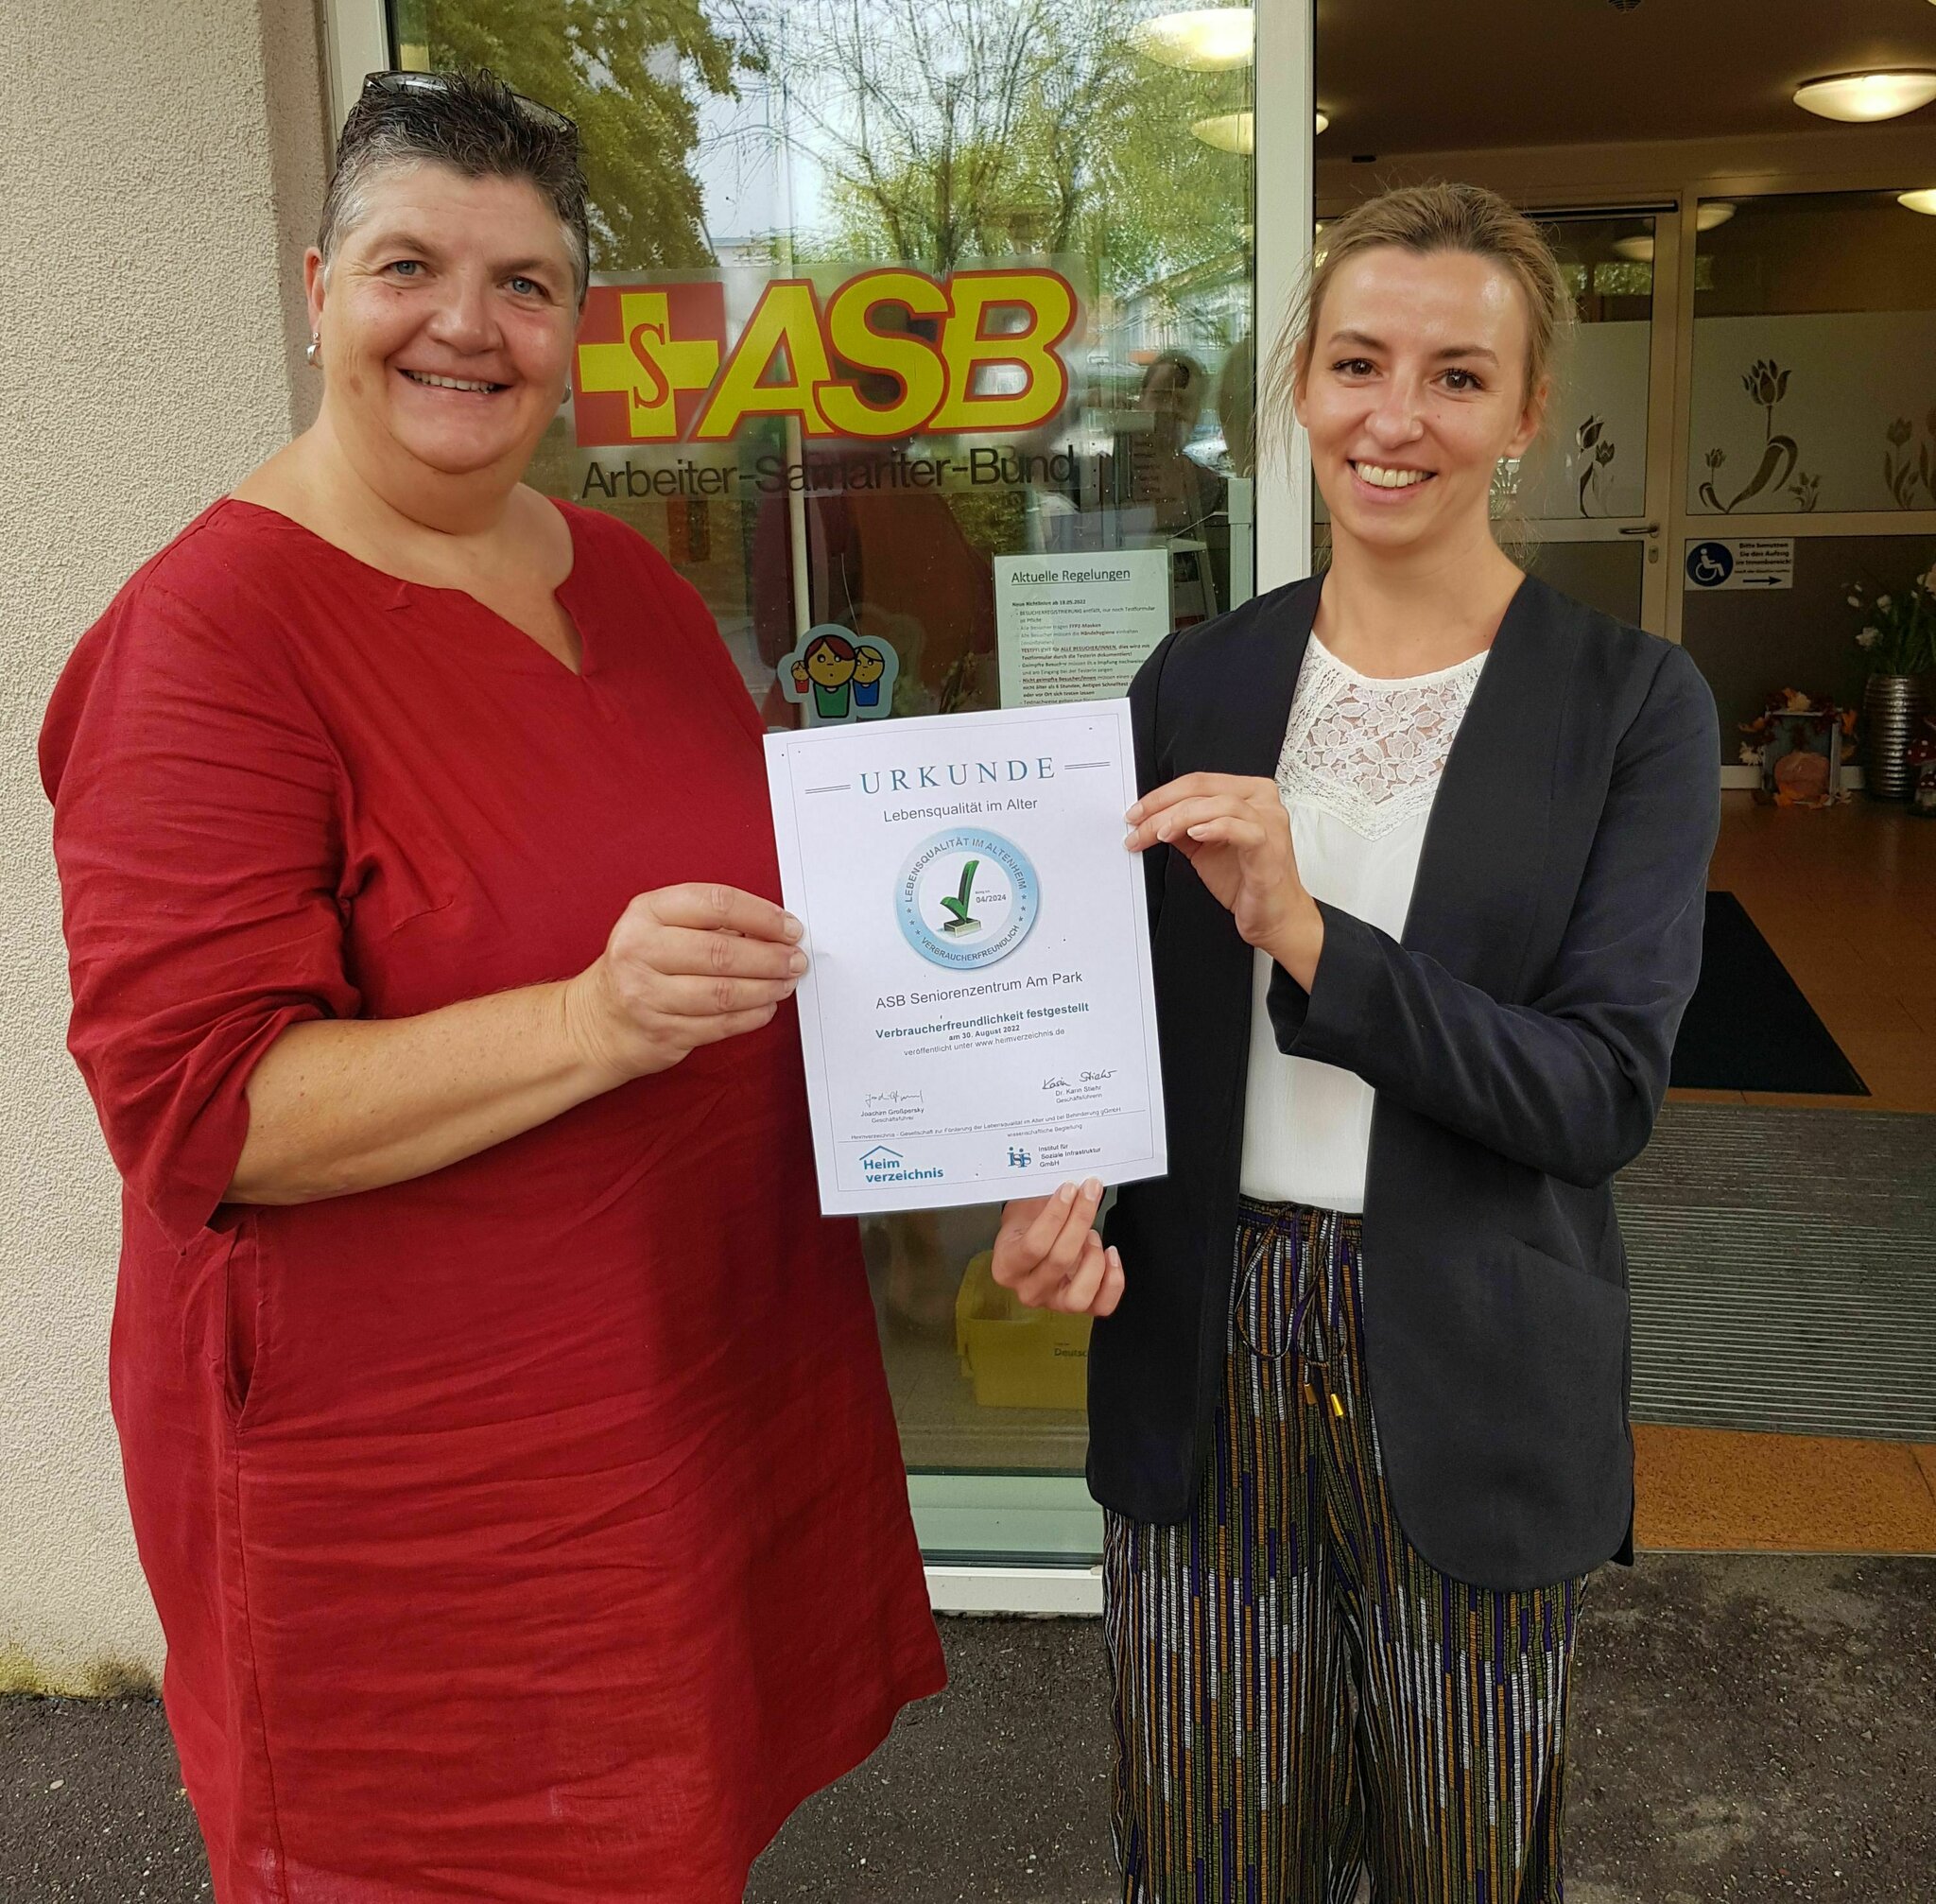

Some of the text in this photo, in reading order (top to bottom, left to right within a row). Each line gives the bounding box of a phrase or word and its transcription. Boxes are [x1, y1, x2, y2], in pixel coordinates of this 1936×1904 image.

[687, 268, 1078, 441] ASB
[581, 443, 1075, 500] Arbeiter-Samariter-Bund
[1011, 569, 1131, 584] Aktuelle Regelungen
[861, 757, 1055, 794] URKUNDE
[884, 798, 1038, 822] Lebensqualität im Alter
[905, 837, 1027, 903] LEBENSQUALITÄT IM ALTENHEIM
[976, 894, 1007, 903] 04/2024
[921, 925, 1020, 961] VERBRAUCHERFREUNDLICH
[875, 971, 1083, 1010] ASB Seniorenzentrum Am Park
[875, 1002, 1090, 1039] Verbraucherfreundlichkeit festgestellt
[975, 1028, 1002, 1038] August
[1003, 1025, 1020, 1033] 2022
[904, 1044, 952, 1056] veröffentlicht
[954, 1041, 973, 1050] unter
[1041, 1147, 1101, 1160] Soziale Infrastruktur
[863, 1158, 900, 1170] Heim
[865, 1168, 943, 1183] verzeichnis
[1054, 1347, 1088, 1358] Deutsc
